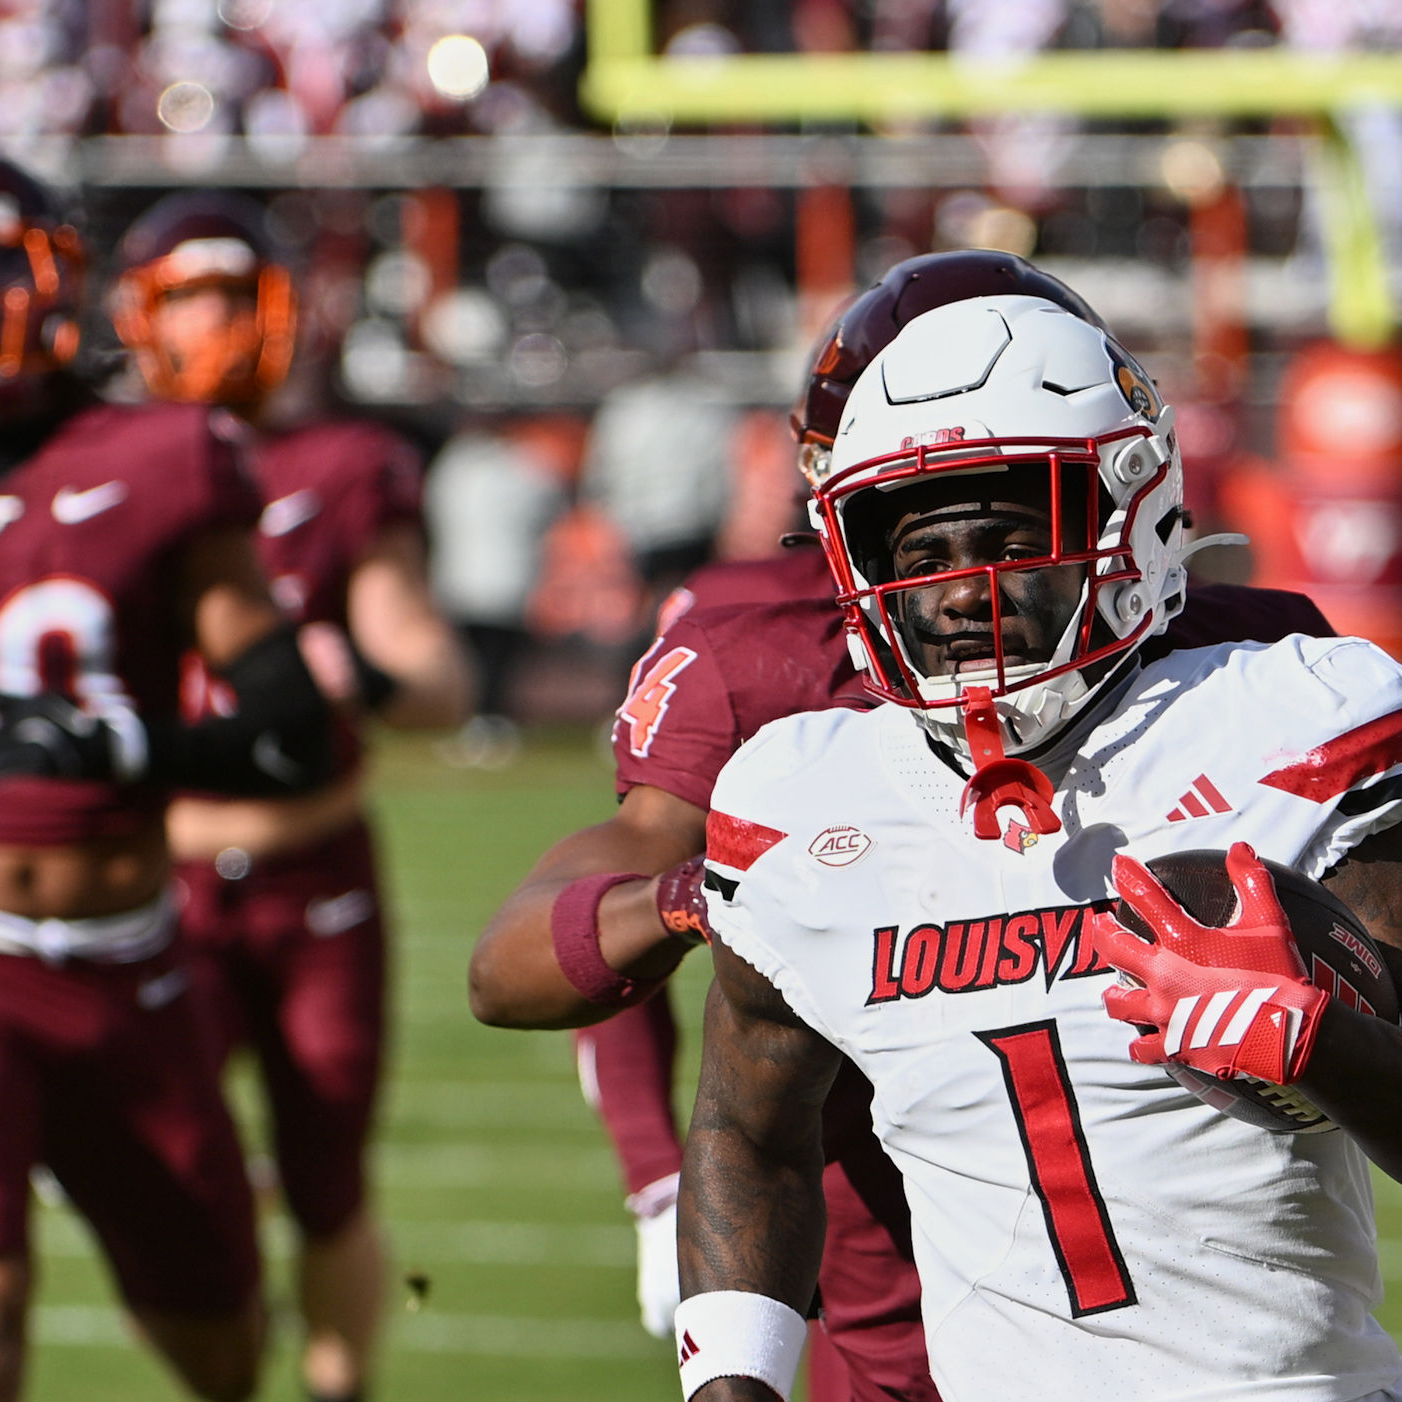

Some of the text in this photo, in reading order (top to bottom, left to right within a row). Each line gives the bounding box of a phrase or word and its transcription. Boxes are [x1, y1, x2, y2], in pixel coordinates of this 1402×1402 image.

[818, 833, 861, 853] ACC
[1328, 911, 1382, 980] DIME
[972, 1018, 1138, 1319] 1
